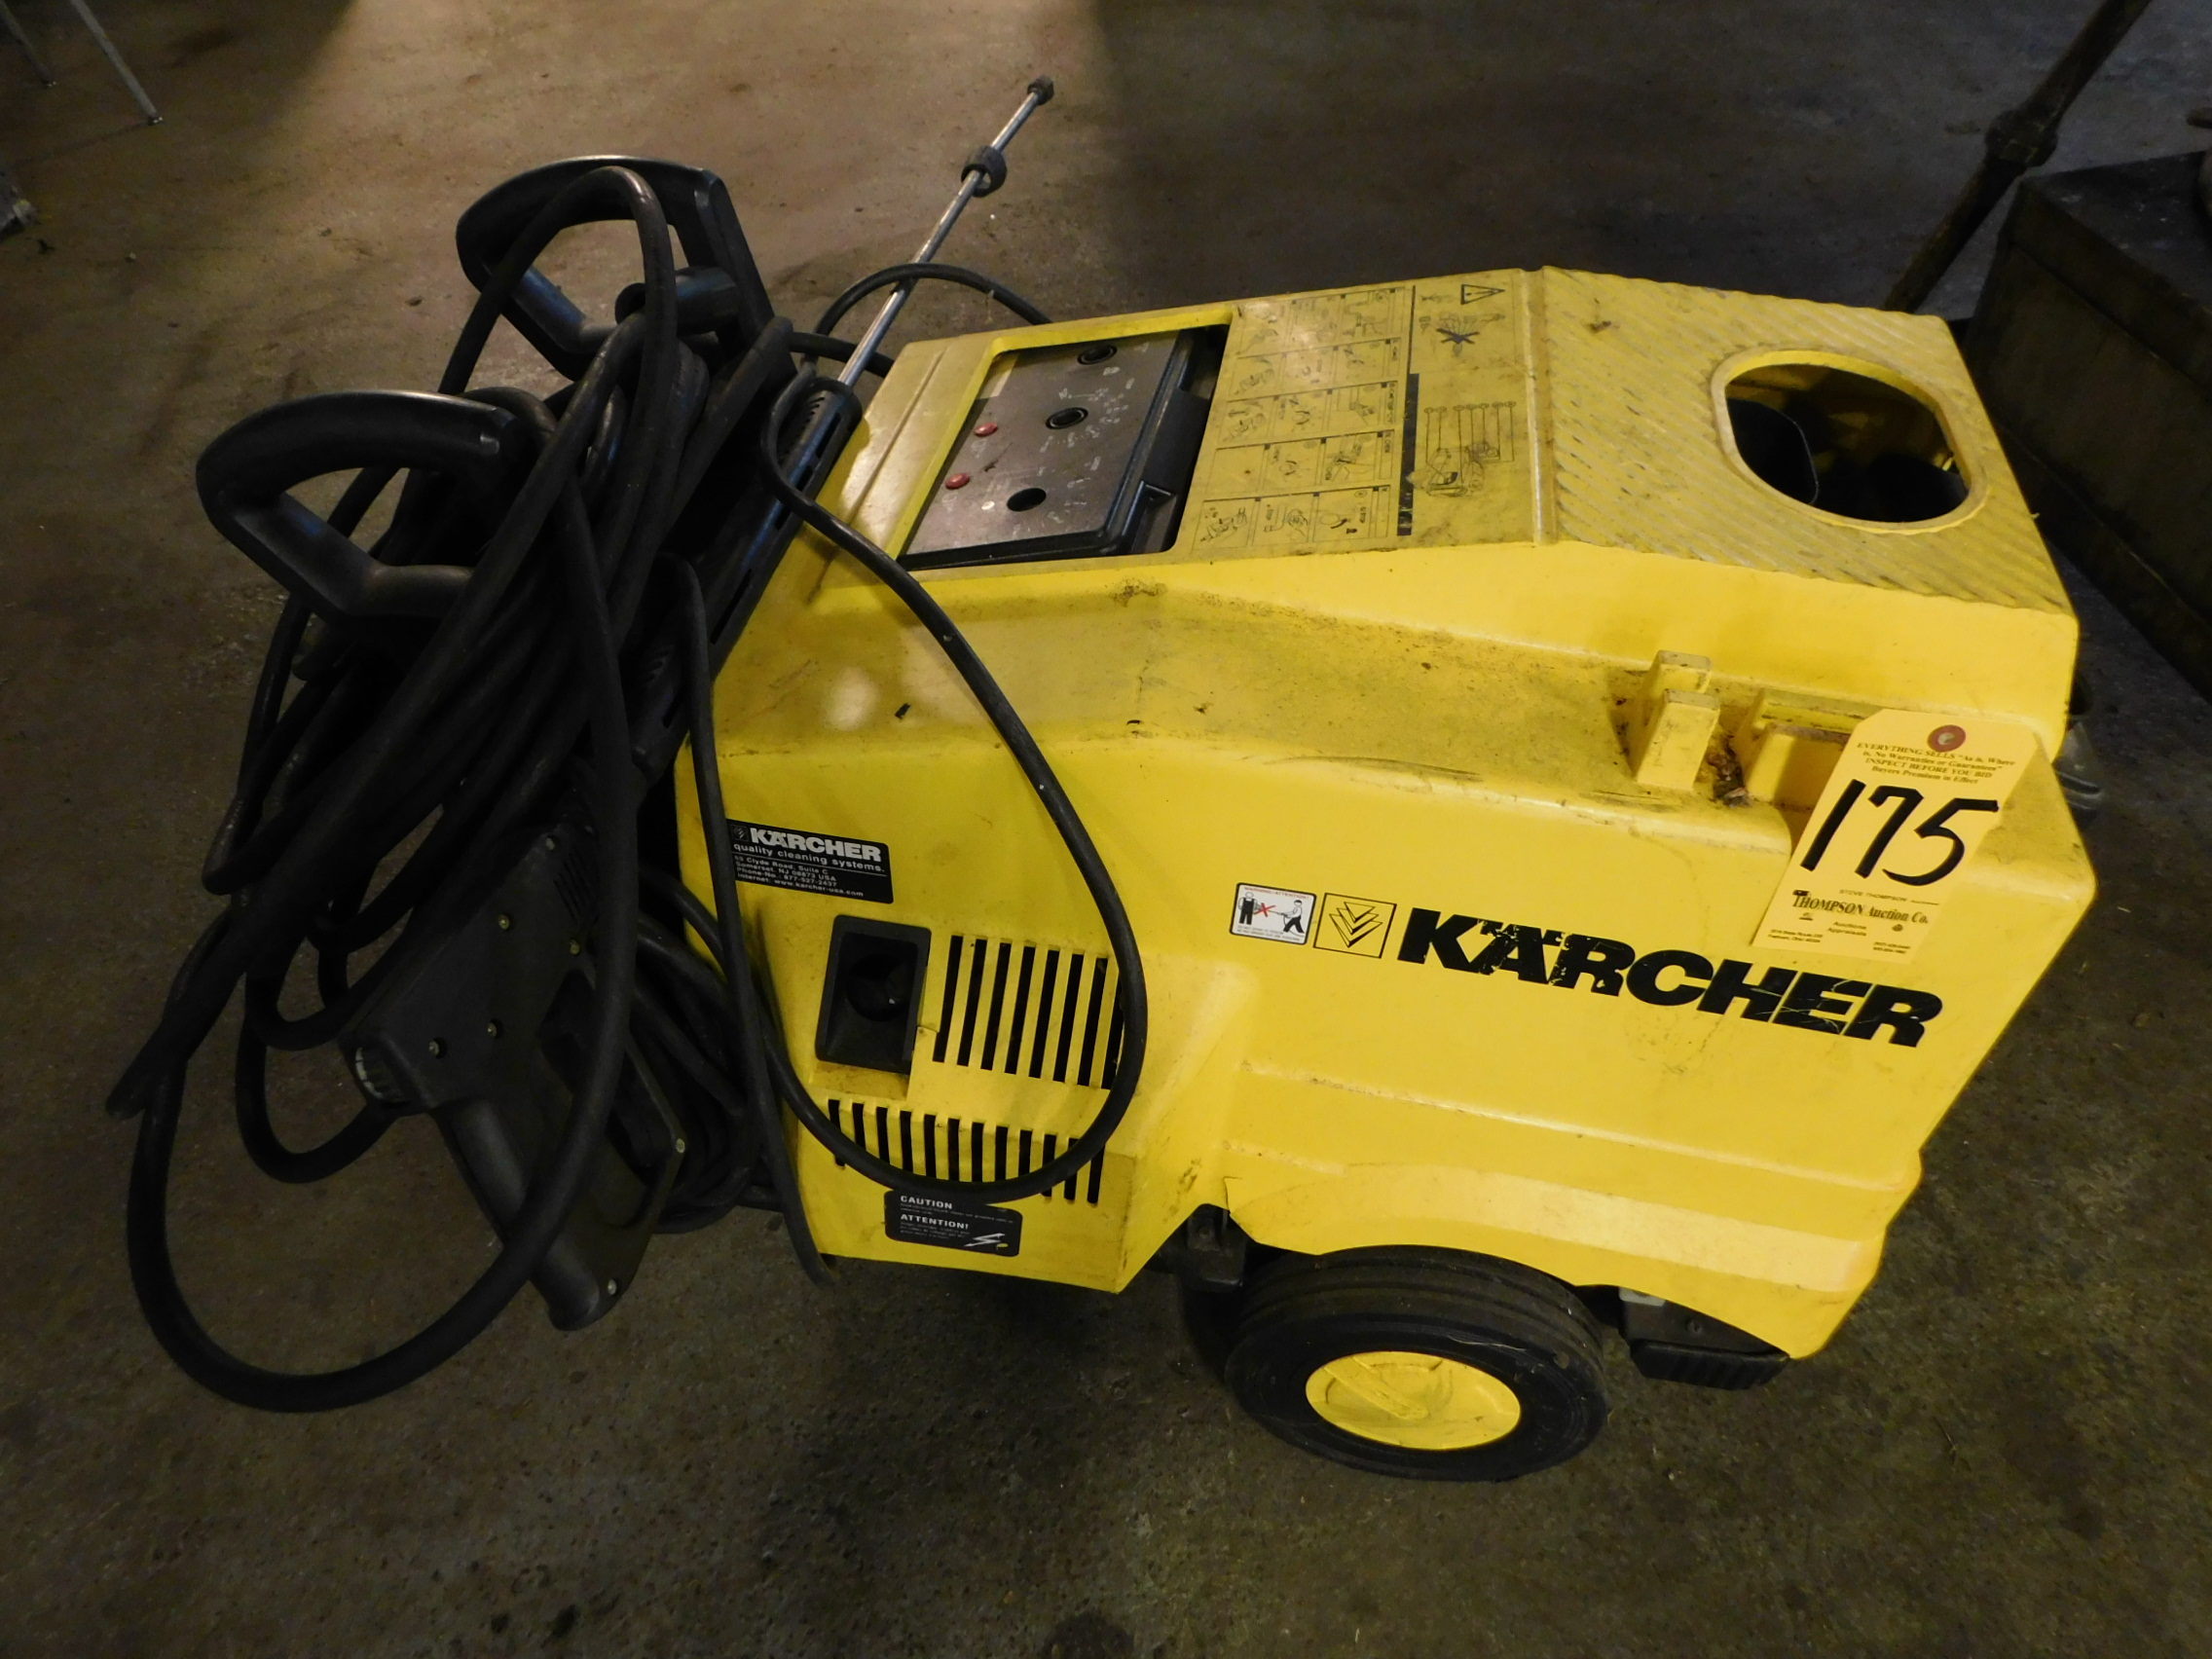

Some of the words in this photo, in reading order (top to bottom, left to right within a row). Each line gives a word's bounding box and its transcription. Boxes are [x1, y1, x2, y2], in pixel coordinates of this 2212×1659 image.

[1857, 743, 1923, 756] EVERYTHING
[1988, 757, 2016, 766] Where
[1889, 753, 1935, 764] Warranties
[1865, 757, 1905, 768] INSPECT
[1908, 763, 1949, 774] BEFORE
[1902, 770, 1941, 780] Premium
[1953, 775, 1978, 785] Effect
[1800, 779, 2000, 887] 175
[750, 828, 882, 863] KÄRCHER
[733, 843, 773, 857] quality
[777, 850, 828, 866] cleaning
[831, 859, 886, 872] systems.
[747, 857, 770, 866] Clyde
[798, 865, 820, 873] Suite
[1792, 893, 1863, 915] THOMPSON
[1867, 905, 1909, 922] Auction
[1911, 911, 1929, 924] Co.
[900, 1195, 953, 1210] CAUTION
[900, 1213, 970, 1230] ATTENTION!
